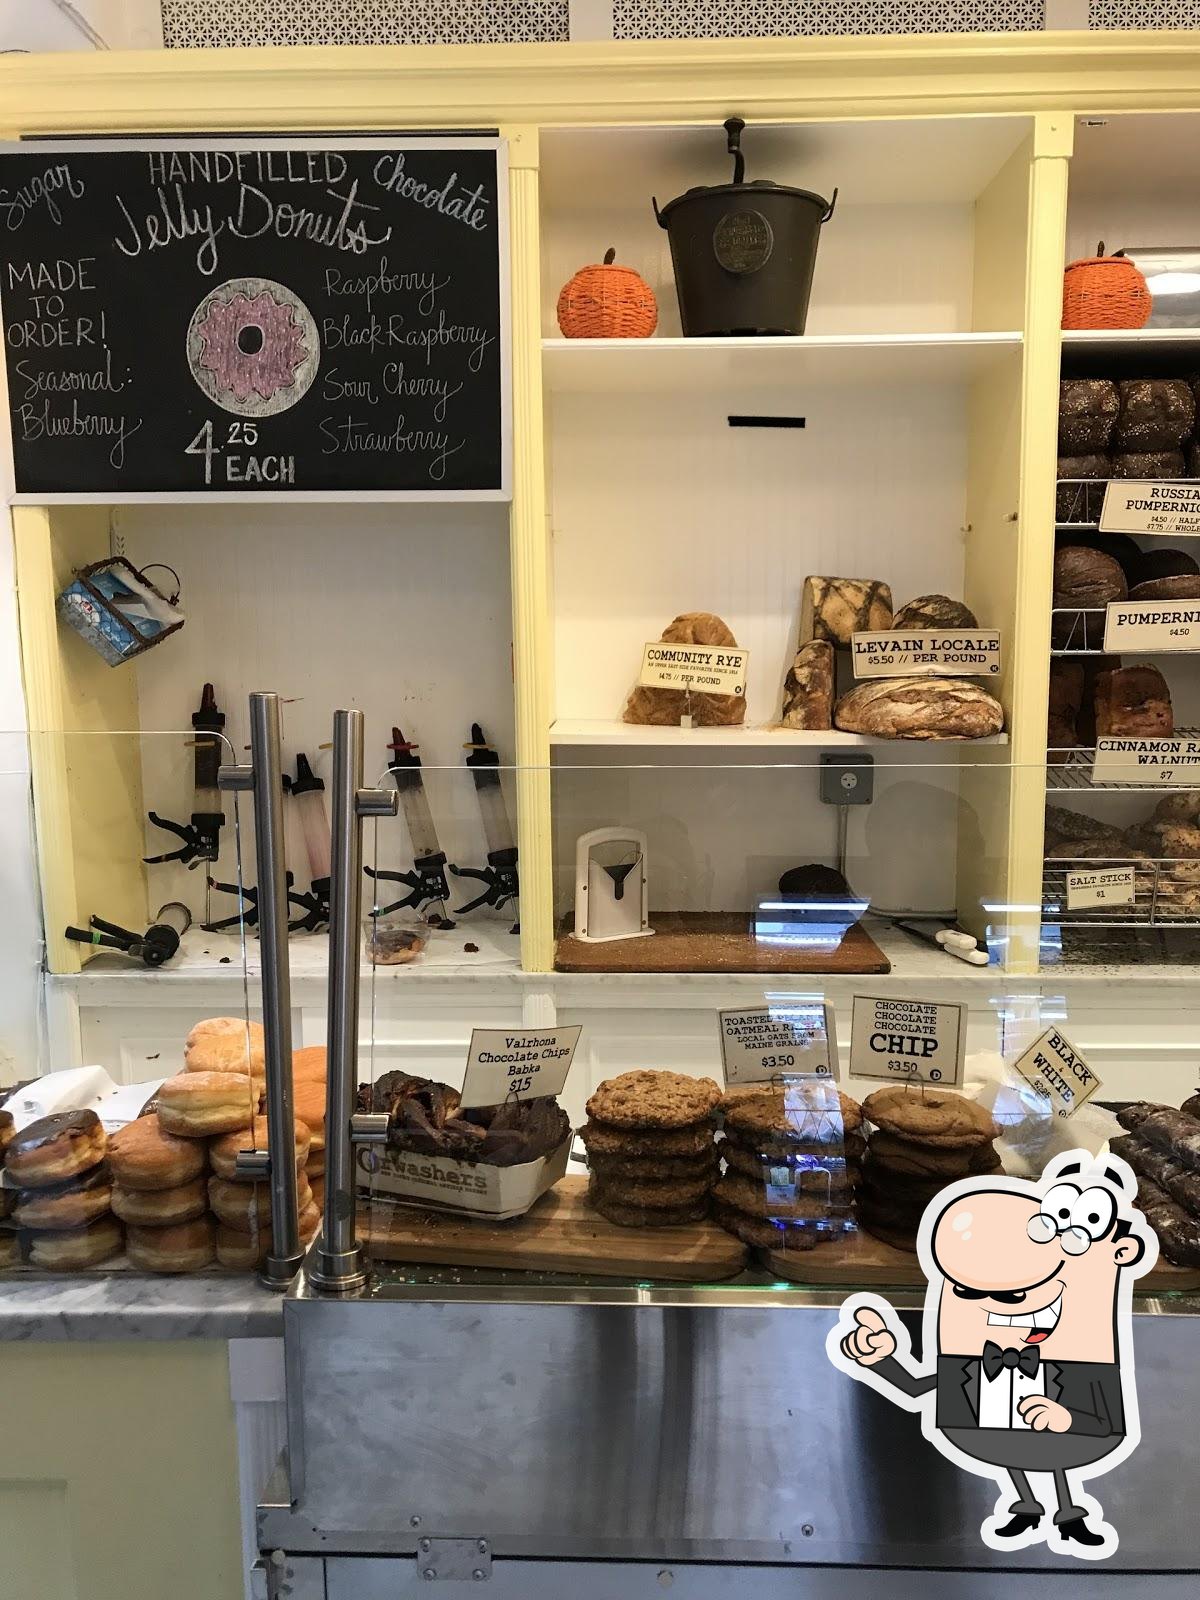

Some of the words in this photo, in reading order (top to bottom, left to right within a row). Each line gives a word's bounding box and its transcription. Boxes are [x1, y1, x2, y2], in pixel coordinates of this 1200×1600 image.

[149, 151, 348, 184] HANDFILLED
[0, 164, 85, 231] Sugar
[373, 153, 490, 231] Chocolate
[114, 183, 226, 276] Jelly
[228, 179, 392, 255] Donuts
[8, 258, 97, 291] MADE
[322, 256, 451, 316] Raspberry
[28, 295, 65, 319] TO
[7, 310, 108, 349] ORDER!
[323, 314, 386, 354] Black
[386, 309, 496, 373] Raspberry
[323, 367, 379, 405] Sour
[383, 362, 464, 423] Cherry
[13, 398, 143, 469] Blueberry
[319, 414, 466, 481] Strawberry
[226, 455, 295, 484] EACH
[855, 640, 924, 654] LEVAIN
[930, 640, 999, 651] LOCALE
[647, 649, 713, 665] COMMUNITY
[716, 655, 743, 668] RYE
[868, 655, 894, 665] $5.50
[913, 653, 939, 663] PER
[943, 654, 987, 663] POUND
[681, 674, 695, 683] PER
[697, 676, 721, 686] POUND
[1099, 740, 1182, 754] CINNAMON
[1160, 771, 1173, 780] $7
[1070, 876, 1096, 886] SALT
[1100, 873, 1132, 883] STICK
[1096, 890, 1106, 898] $1
[875, 1001, 938, 1015] CHOCOLATE
[874, 1011, 937, 1025] CHOCOLATE
[726, 1024, 779, 1036] OATMEAL
[874, 1021, 936, 1035] CHOCOLATE
[505, 1037, 557, 1049] Valrhona
[737, 1034, 765, 1043] LOCAL
[768, 1033, 789, 1041] OATS
[744, 1041, 773, 1050] MAINE
[869, 1032, 939, 1058] CHIP
[478, 1051, 539, 1063] Chocolate
[541, 1048, 571, 1060] Chips
[761, 1055, 795, 1068] $3.50
[1047, 1033, 1093, 1086] BLACK
[507, 1063, 541, 1076] Babka
[887, 1060, 918, 1073] $3.50
[509, 1077, 533, 1092] $15
[1032, 1052, 1075, 1103] WHITE
